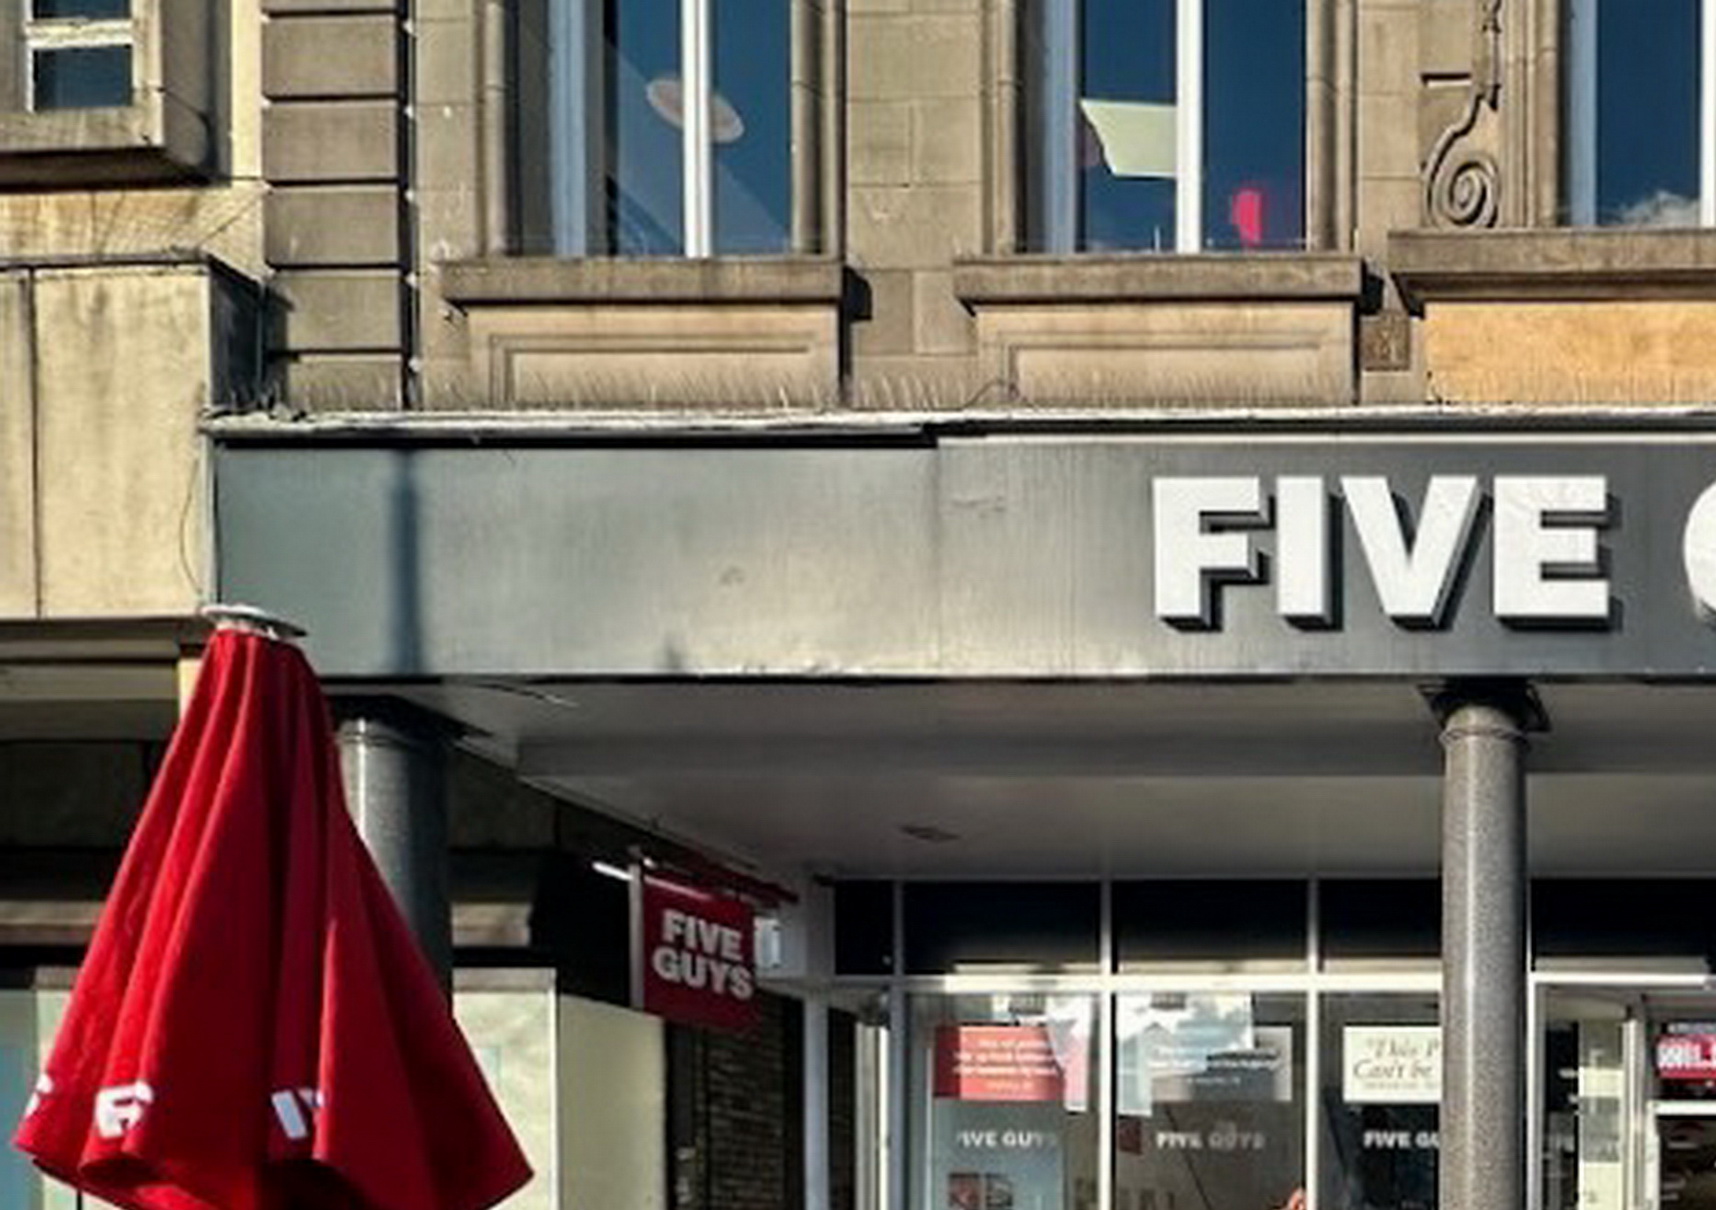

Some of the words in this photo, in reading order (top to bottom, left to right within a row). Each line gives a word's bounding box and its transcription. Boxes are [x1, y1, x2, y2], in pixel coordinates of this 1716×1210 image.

[1152, 475, 1620, 630] FIVE
[662, 908, 743, 961] FIVE
[653, 946, 753, 1000] GUYS
[1156, 1131, 1202, 1149] FIVE
[1363, 1130, 1411, 1149] FIVE
